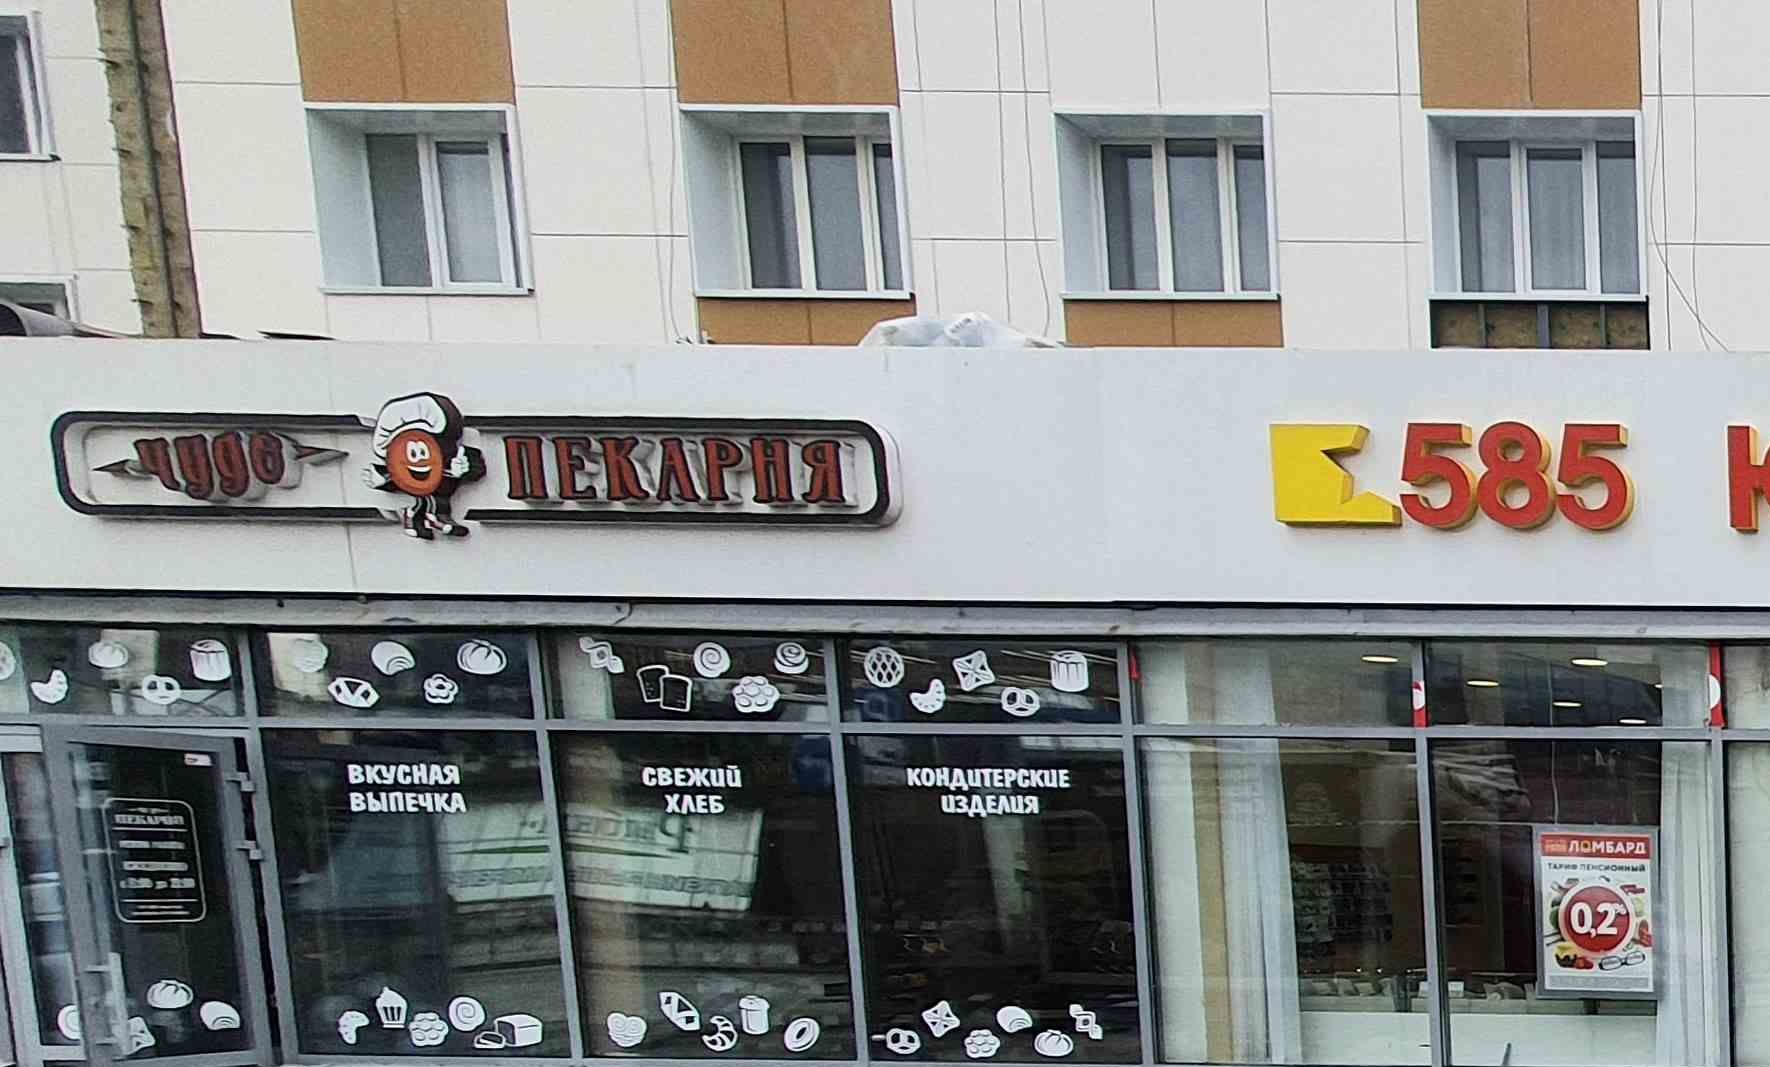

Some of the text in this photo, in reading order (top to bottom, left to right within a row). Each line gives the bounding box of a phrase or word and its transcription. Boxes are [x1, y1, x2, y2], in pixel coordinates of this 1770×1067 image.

[503, 436, 847, 504] ПЕКАРНЯ
[1400, 421, 1636, 532] 585
[347, 763, 461, 785] ВКУСНАЯ
[642, 764, 742, 787] СВЕЖИЙ
[906, 767, 1072, 791] КОНДИТЕРСКИЕ
[349, 791, 467, 813] ВЫПЕЧКА
[664, 793, 725, 814] ХЛЕБ
[940, 794, 1040, 818] ИЗДЕЛИЯ
[1568, 839, 1646, 854] ЛОМБАРД
